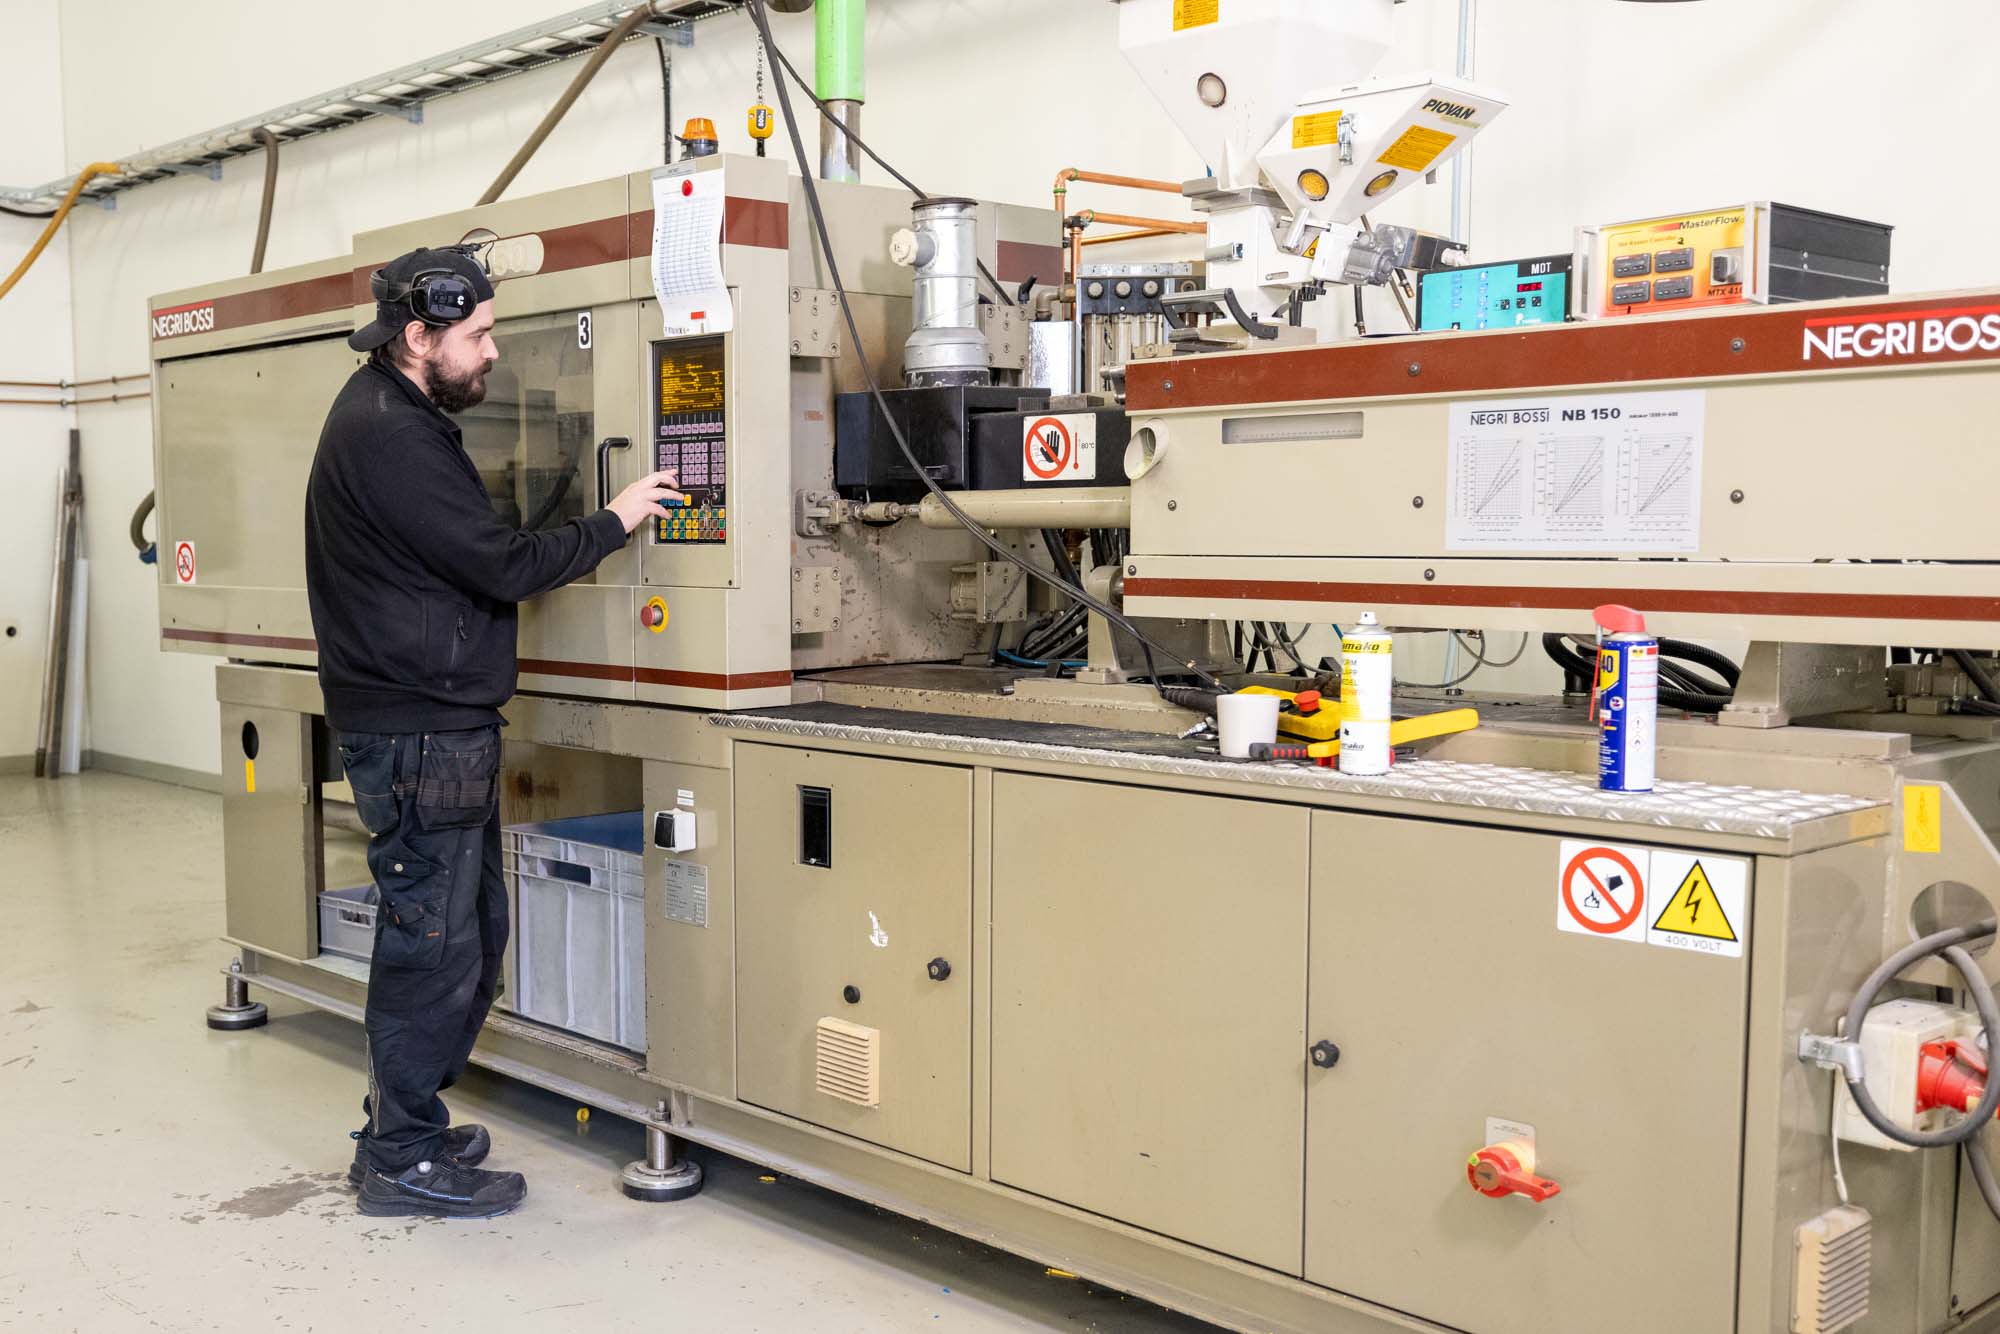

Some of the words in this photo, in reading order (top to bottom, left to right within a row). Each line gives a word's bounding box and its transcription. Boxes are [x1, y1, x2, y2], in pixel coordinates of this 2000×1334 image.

[1422, 98, 1476, 120] PIOVAN
[1678, 216, 1740, 230] MasterFlow
[1531, 262, 1552, 275] MDT
[152, 312, 183, 338] NEGRI
[183, 307, 214, 333] BOSSI
[579, 315, 590, 346] 3
[1802, 320, 1917, 361] NEGRI
[1470, 411, 1508, 426] NEGRI
[1513, 410, 1550, 424] BOSSI
[1561, 409, 1586, 422] NB
[1591, 407, 1621, 420] 150
[1665, 935, 1688, 947] 400
[1692, 938, 1722, 953] VOLT
